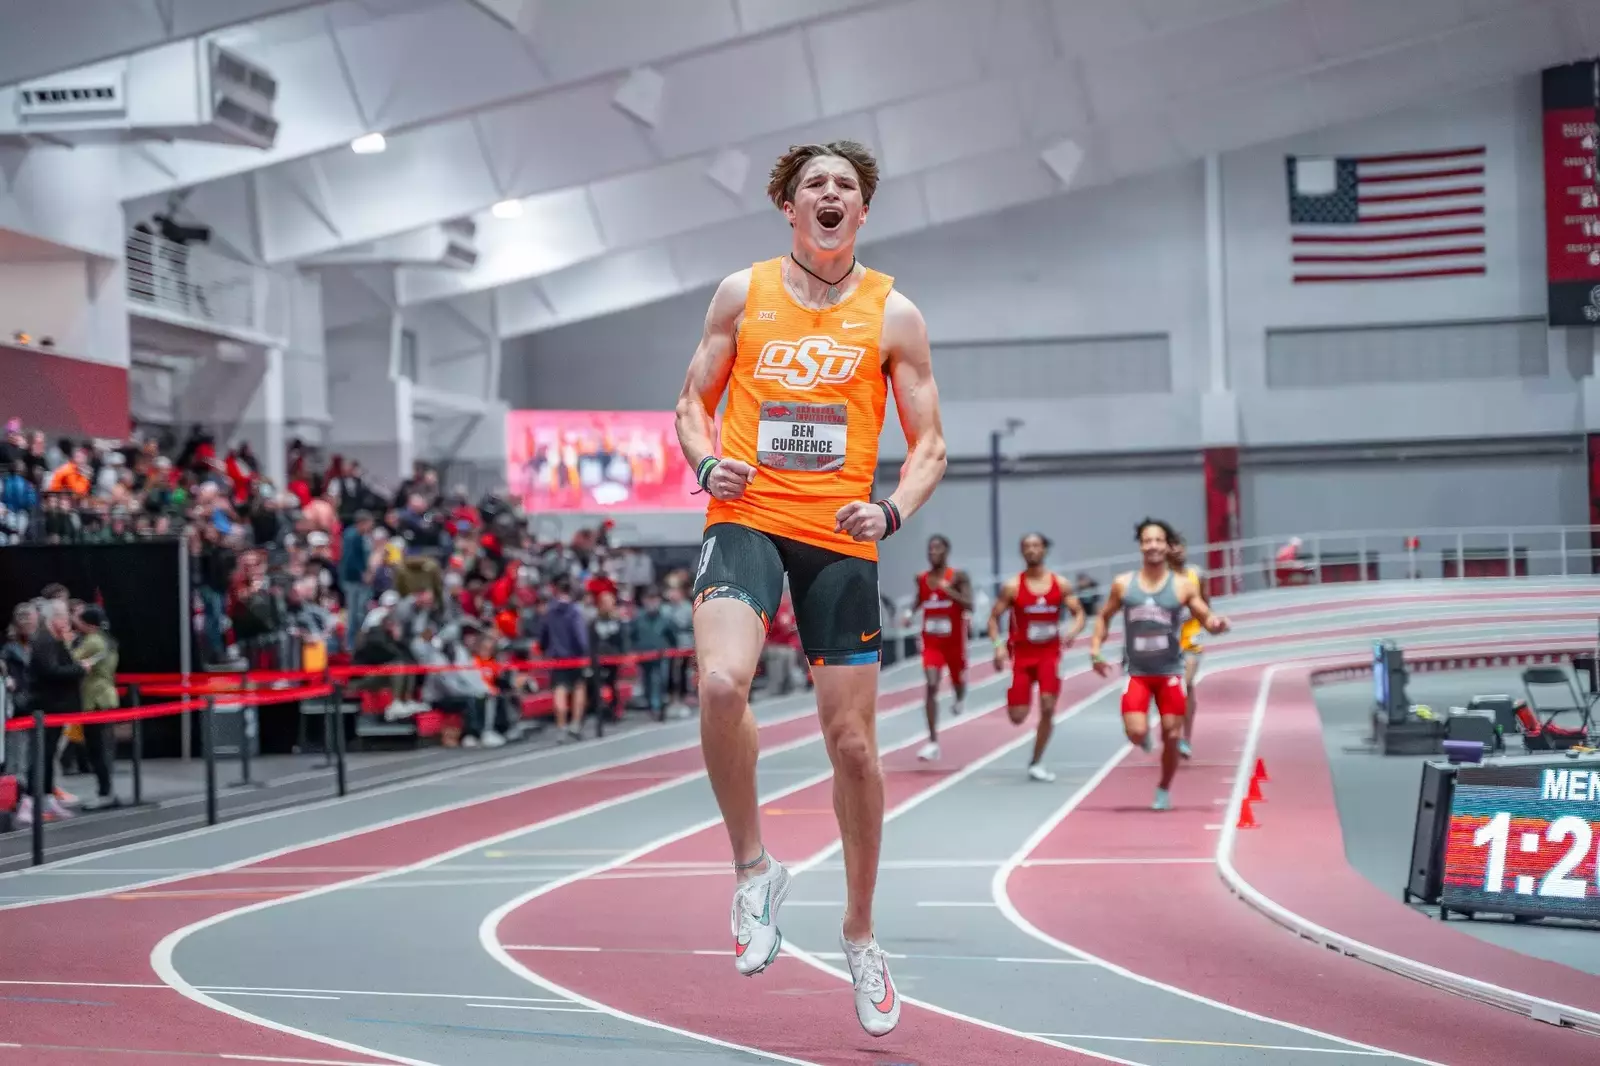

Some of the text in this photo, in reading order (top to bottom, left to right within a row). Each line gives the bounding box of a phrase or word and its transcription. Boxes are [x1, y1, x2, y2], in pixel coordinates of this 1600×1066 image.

[754, 336, 866, 390] OSU
[771, 438, 833, 453] CURRENCE
[791, 424, 815, 438] BEN
[1473, 812, 1600, 898] 1:2
